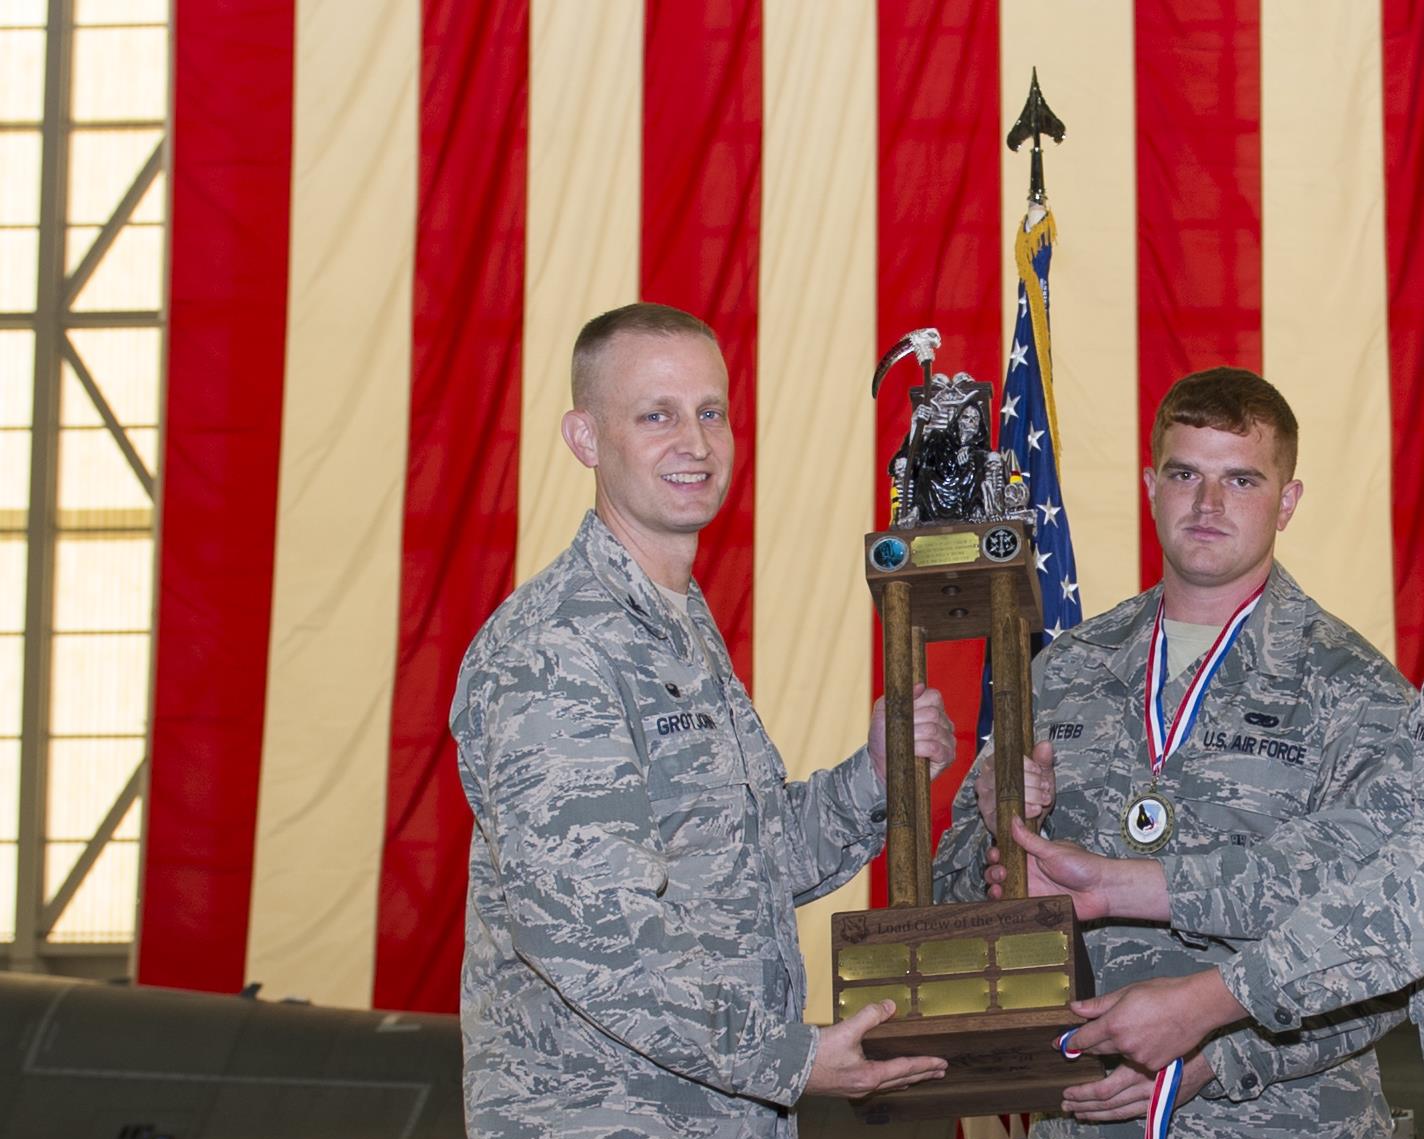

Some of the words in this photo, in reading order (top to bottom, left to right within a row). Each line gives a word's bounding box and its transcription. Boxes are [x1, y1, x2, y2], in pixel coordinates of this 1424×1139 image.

[1048, 722, 1084, 740] WEBB
[1202, 729, 1228, 748] U.S.
[1231, 733, 1258, 754] AIR
[1258, 739, 1307, 764] FORCE
[877, 922, 912, 935] Load
[914, 918, 950, 930] Crew
[953, 915, 968, 928] of
[970, 914, 992, 927] the
[995, 912, 1026, 926] Year
